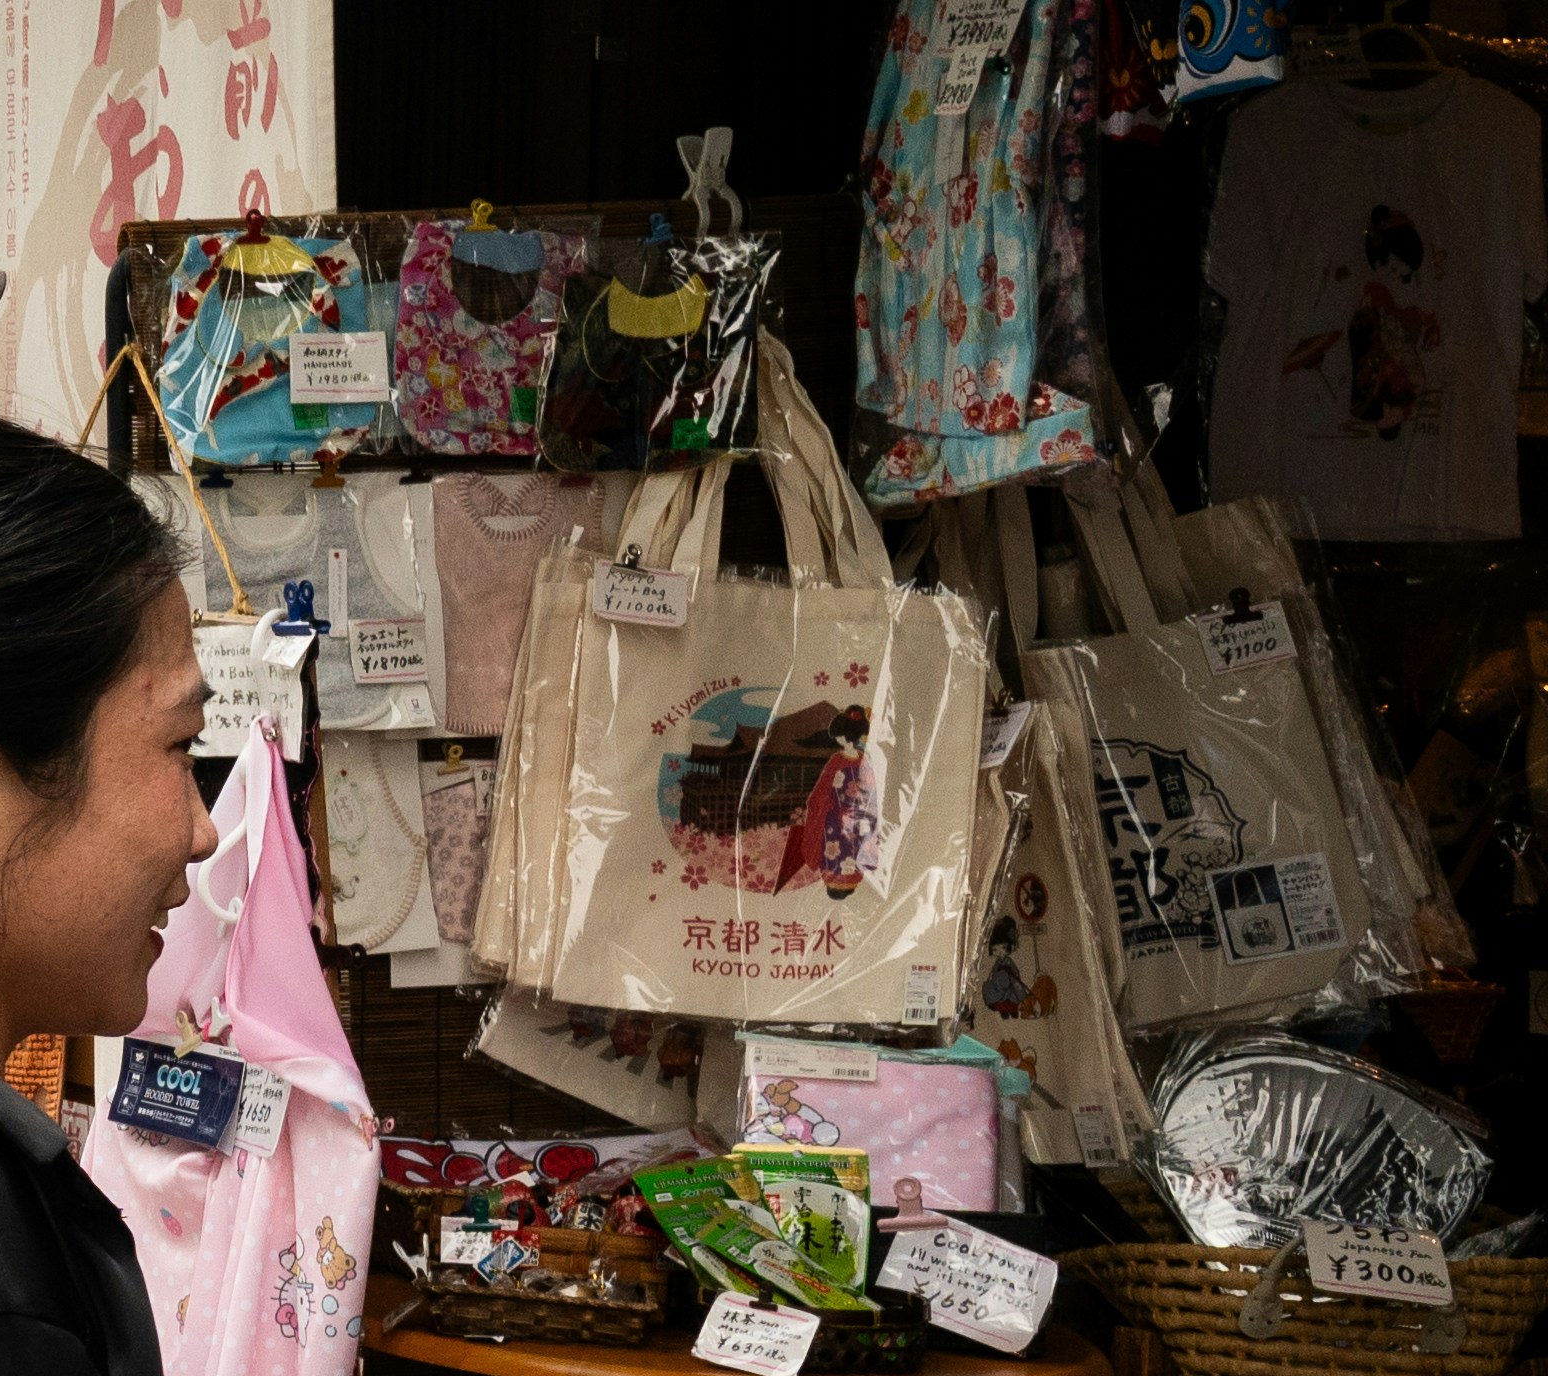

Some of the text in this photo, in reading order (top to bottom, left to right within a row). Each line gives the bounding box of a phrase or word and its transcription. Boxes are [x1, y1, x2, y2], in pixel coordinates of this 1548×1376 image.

[1219, 637, 1276, 665] ¥1100
[664, 677, 728, 727] Kiyomizu
[1160, 773, 1190, 814] 古都
[1130, 944, 1174, 960] JAPAN
[692, 958, 835, 980] KYOTO JAPAN
[157, 1065, 202, 1095] COOL
[144, 1088, 200, 1110] HOODED TOWEL
[1339, 1240, 1432, 1260] Japanese Fan
[913, 1276, 989, 1321] ¥1650
[723, 1309, 756, 1325] 抹茶
